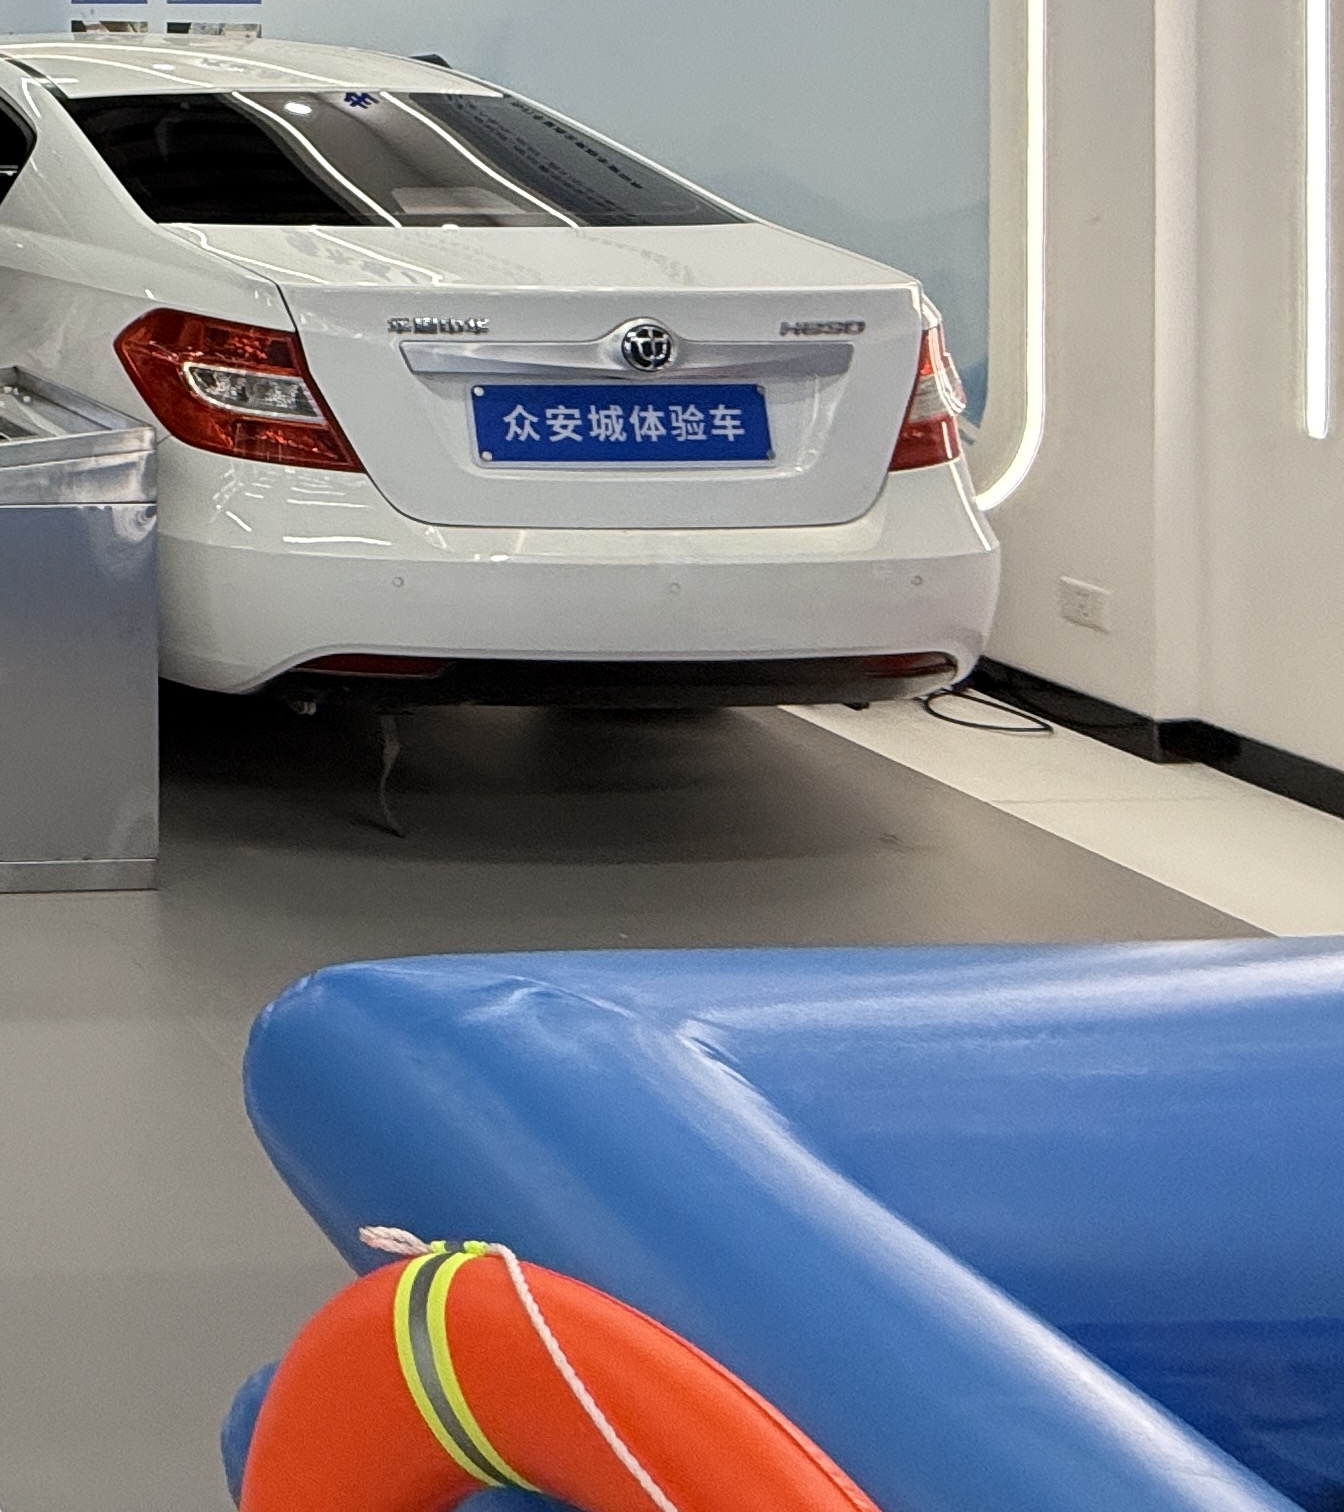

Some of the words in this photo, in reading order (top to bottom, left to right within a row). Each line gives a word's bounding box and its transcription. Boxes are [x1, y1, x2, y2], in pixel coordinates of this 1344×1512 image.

[503, 404, 746, 443] 众安城体验车
